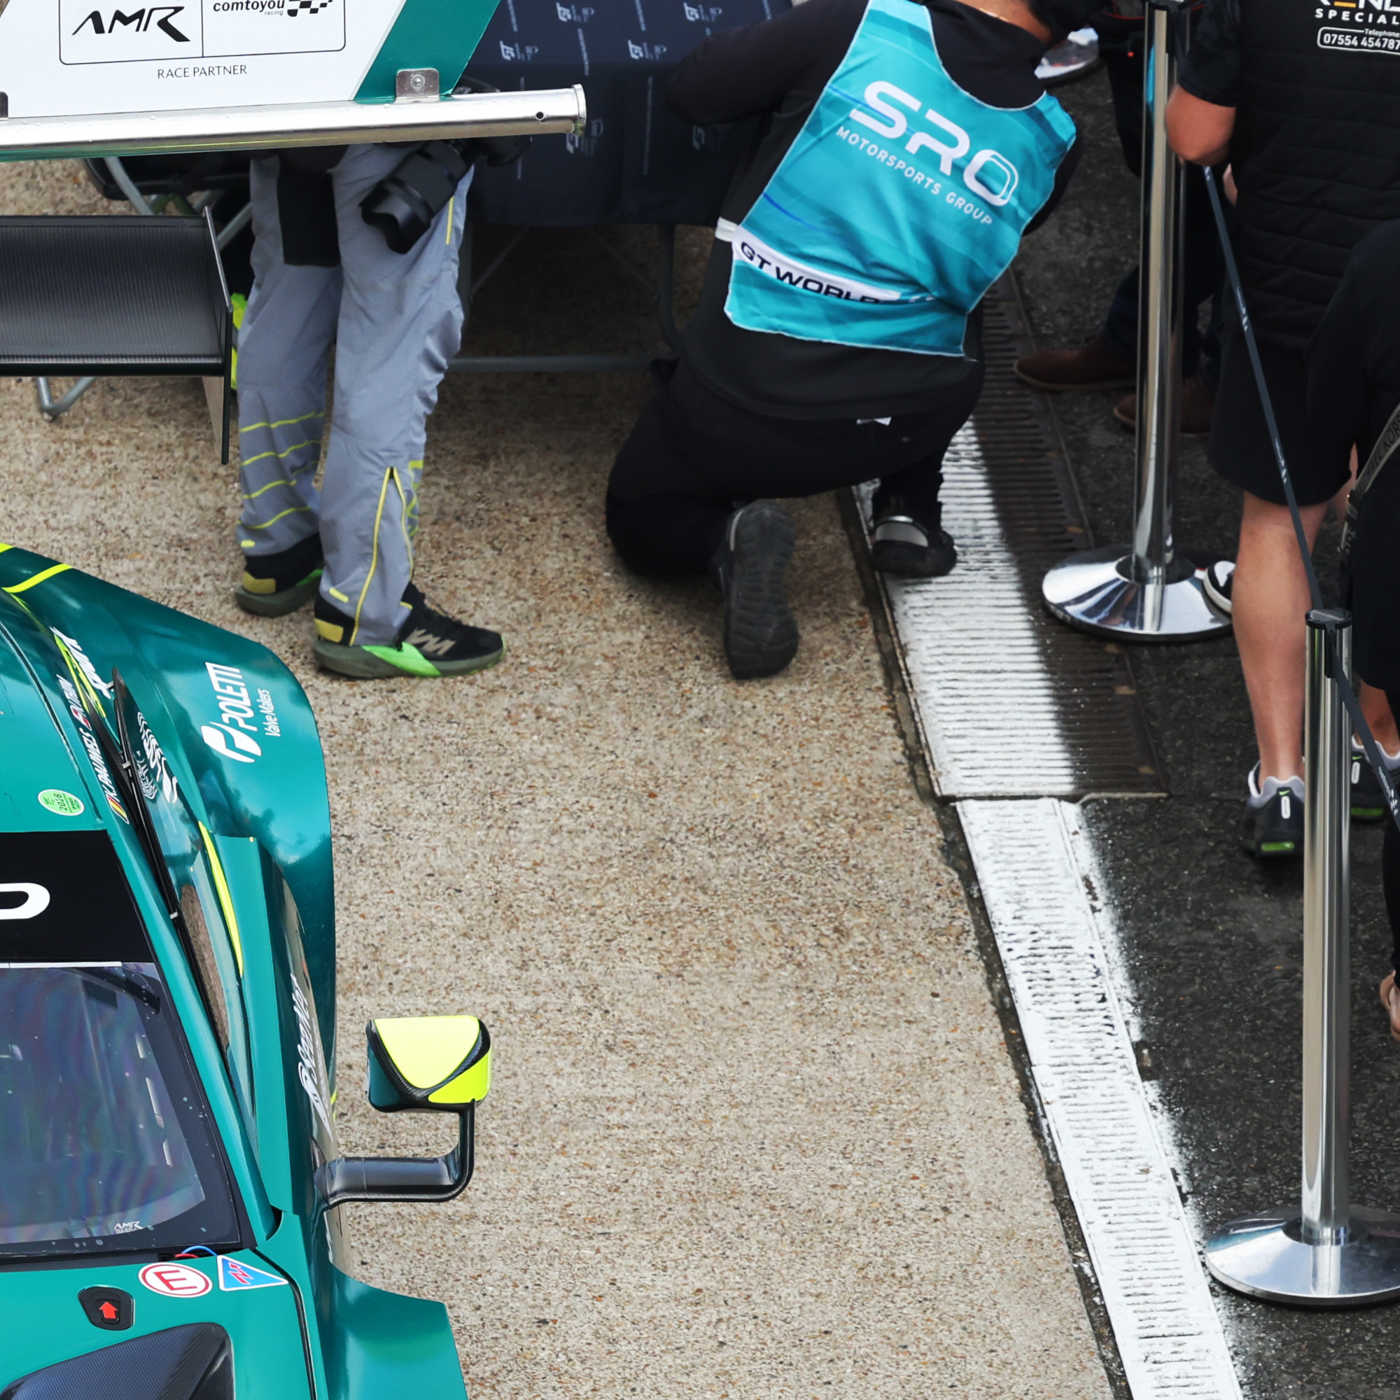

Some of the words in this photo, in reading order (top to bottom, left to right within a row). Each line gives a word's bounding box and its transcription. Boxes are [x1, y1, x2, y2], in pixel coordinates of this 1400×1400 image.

[72, 6, 191, 42] AMR
[1323, 33, 1358, 47] 07554
[1360, 37, 1400, 50] 454787
[157, 68, 191, 79] RACE
[192, 64, 247, 77] PARTNER
[849, 81, 1019, 206] SRO
[836, 126, 941, 196] MOTORSPORTS
[945, 190, 993, 226] GROUP
[740, 241, 771, 272] GT
[205, 661, 258, 731] POLETTI
[154, 1270, 197, 1291] E
